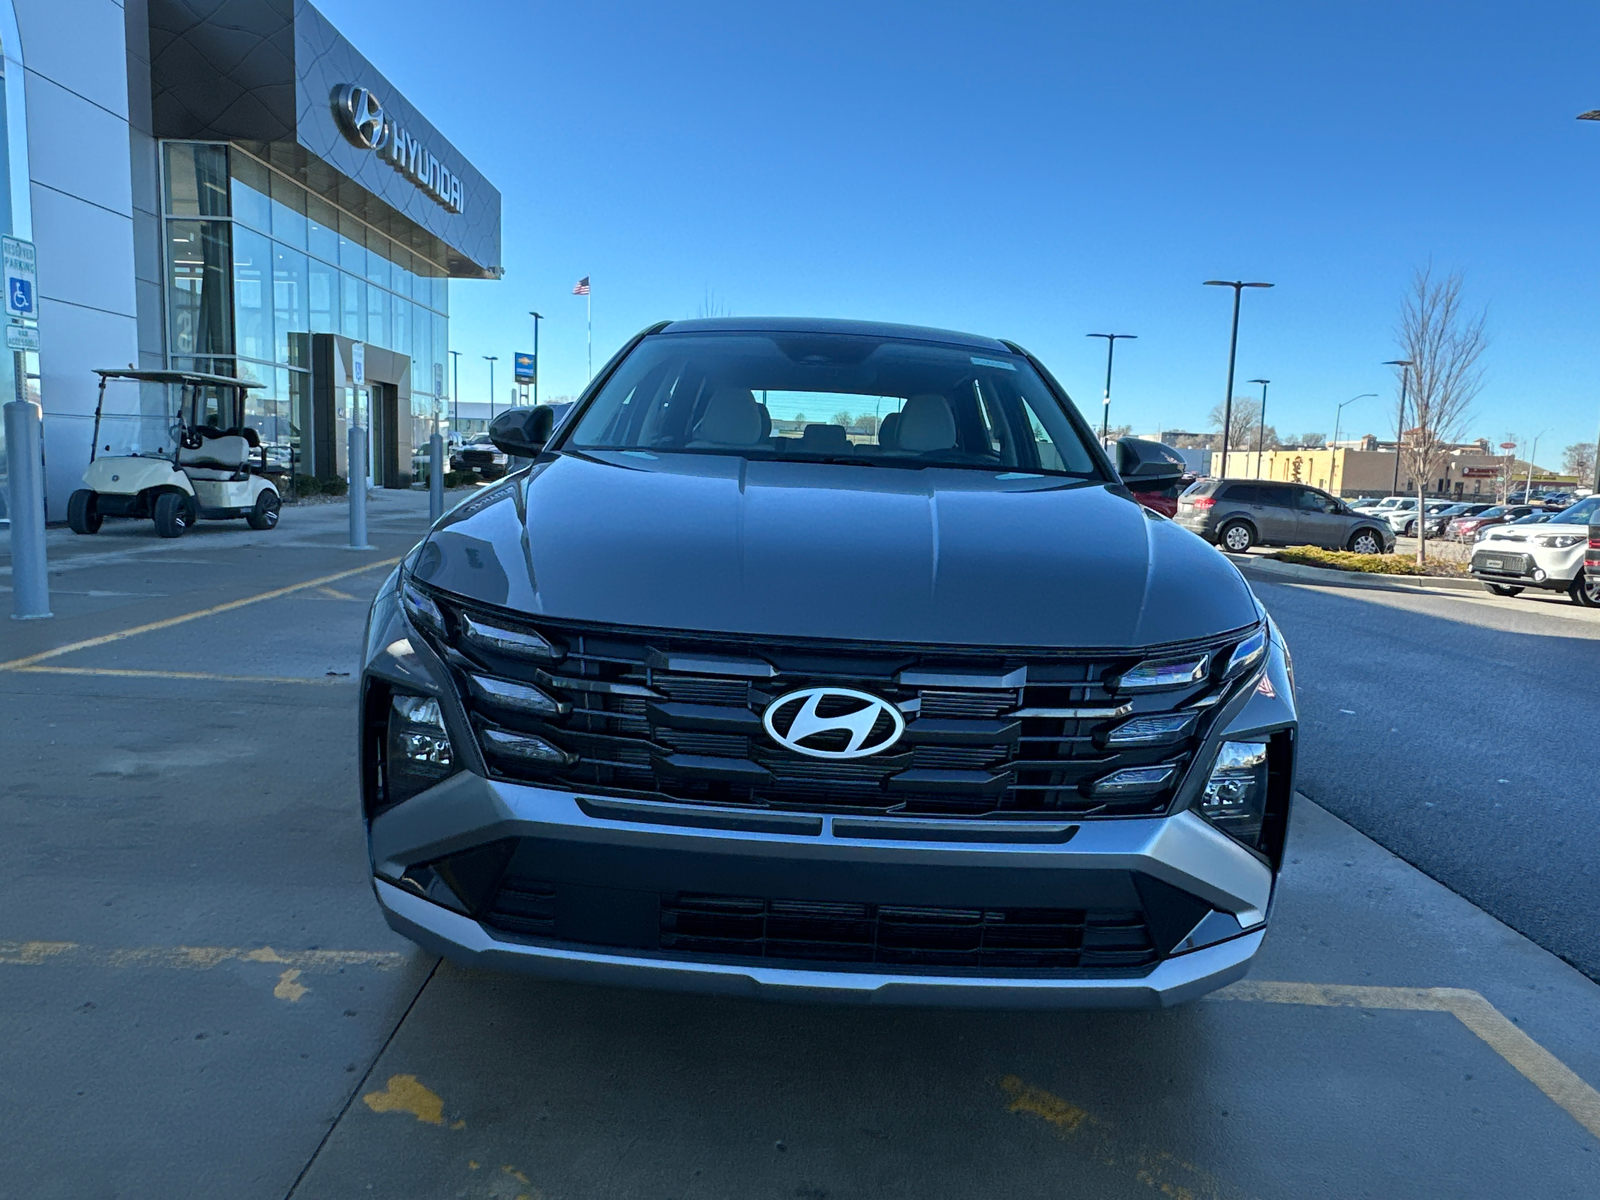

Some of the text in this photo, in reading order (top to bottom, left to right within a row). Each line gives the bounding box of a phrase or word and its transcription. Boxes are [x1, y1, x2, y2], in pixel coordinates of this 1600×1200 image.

[392, 121, 464, 214] HYUNDAI
[4, 242, 33, 260] RESERVED
[5, 257, 34, 274] PARKING
